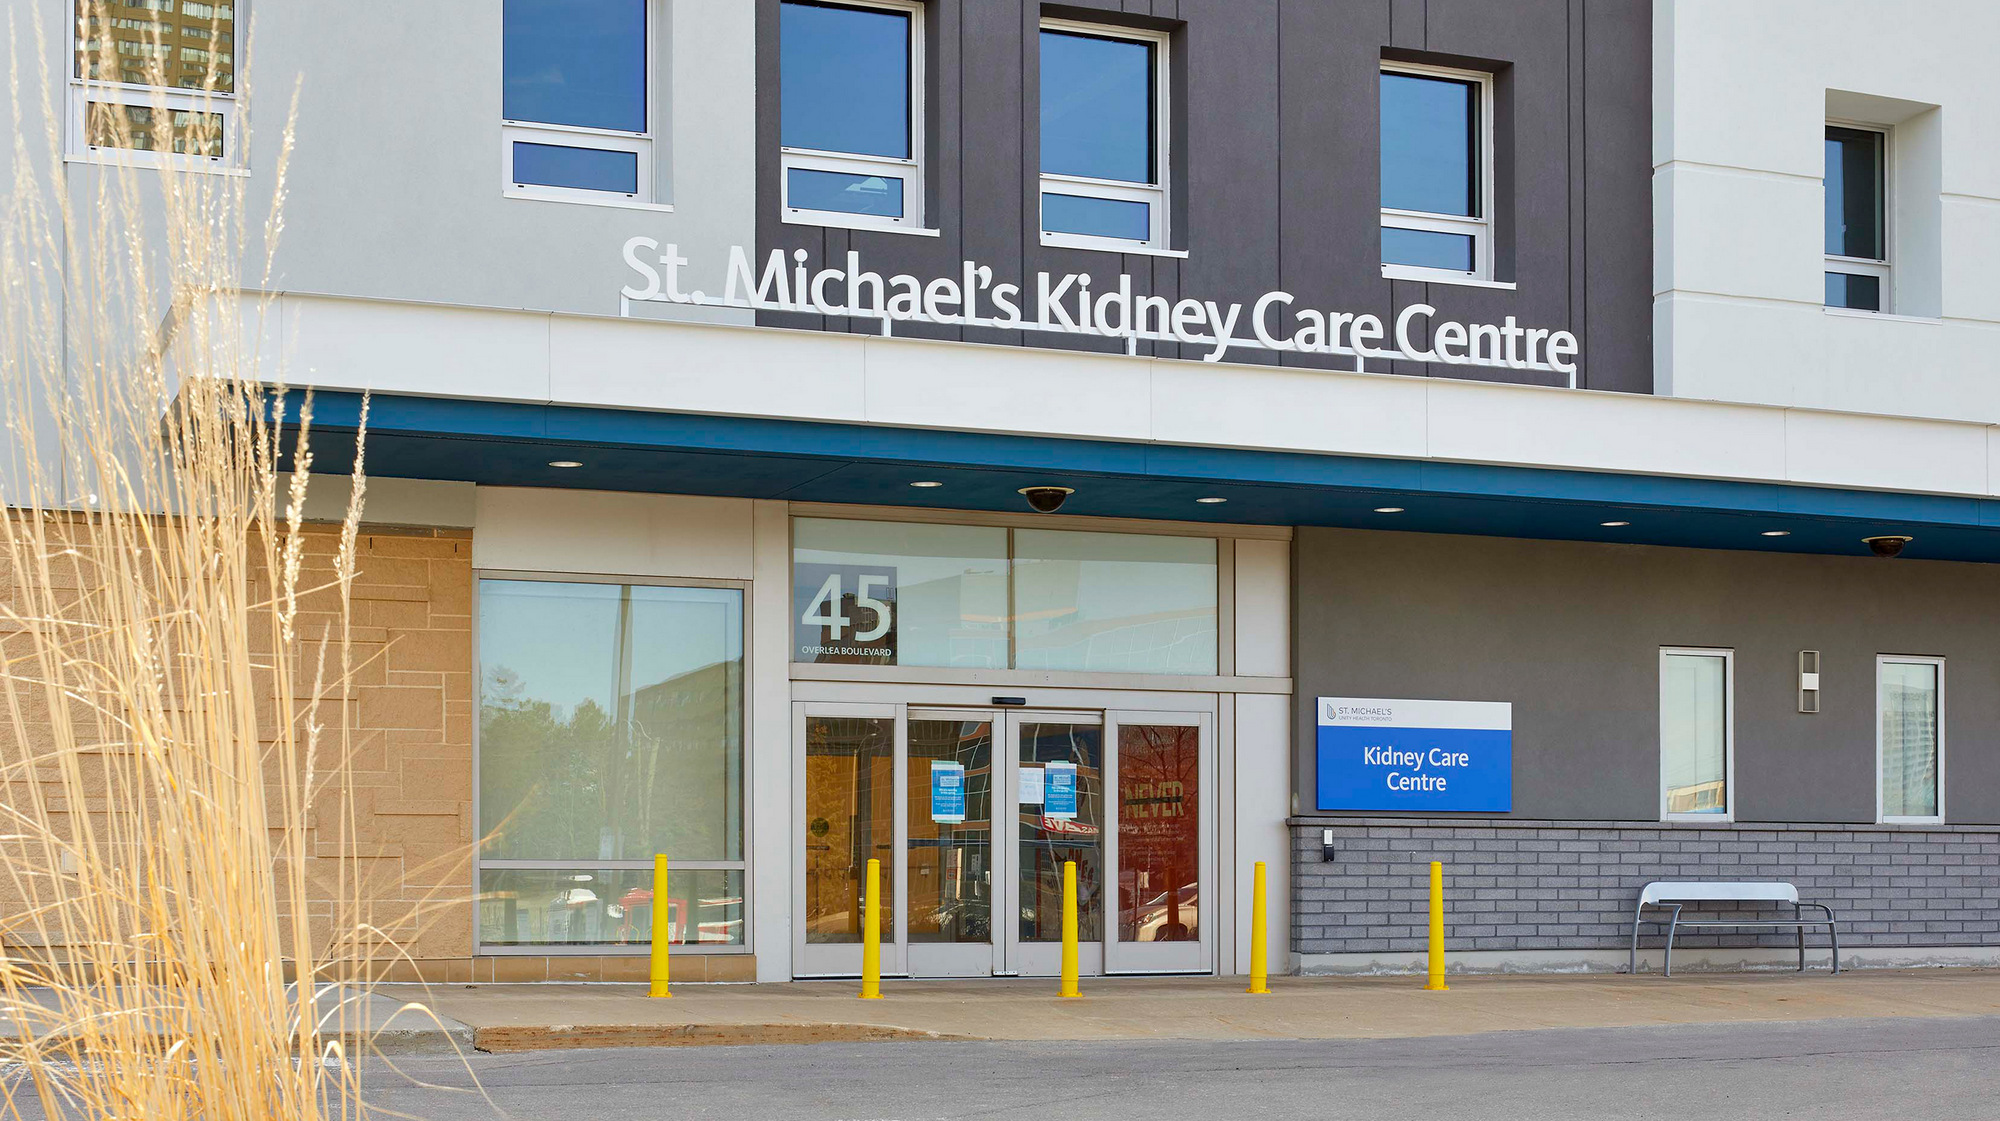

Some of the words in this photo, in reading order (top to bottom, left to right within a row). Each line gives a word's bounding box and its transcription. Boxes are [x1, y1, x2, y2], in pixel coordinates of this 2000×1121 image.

[621, 236, 706, 305] St.
[723, 245, 1022, 329] Michael's
[1037, 271, 1243, 363] Kidney
[1252, 290, 1384, 359] Care
[1395, 303, 1579, 373] Centre
[801, 573, 892, 642] 45
[801, 645, 840, 655] OVERLEA
[841, 647, 892, 657] BOULEVARD
[1338, 706, 1350, 715] ST.
[1351, 707, 1393, 716] MICHAEL'S
[1364, 746, 1425, 771] Kidney
[1428, 747, 1469, 767] Care
[1386, 771, 1447, 791] Centre
[1124, 781, 1185, 818] NEVER
